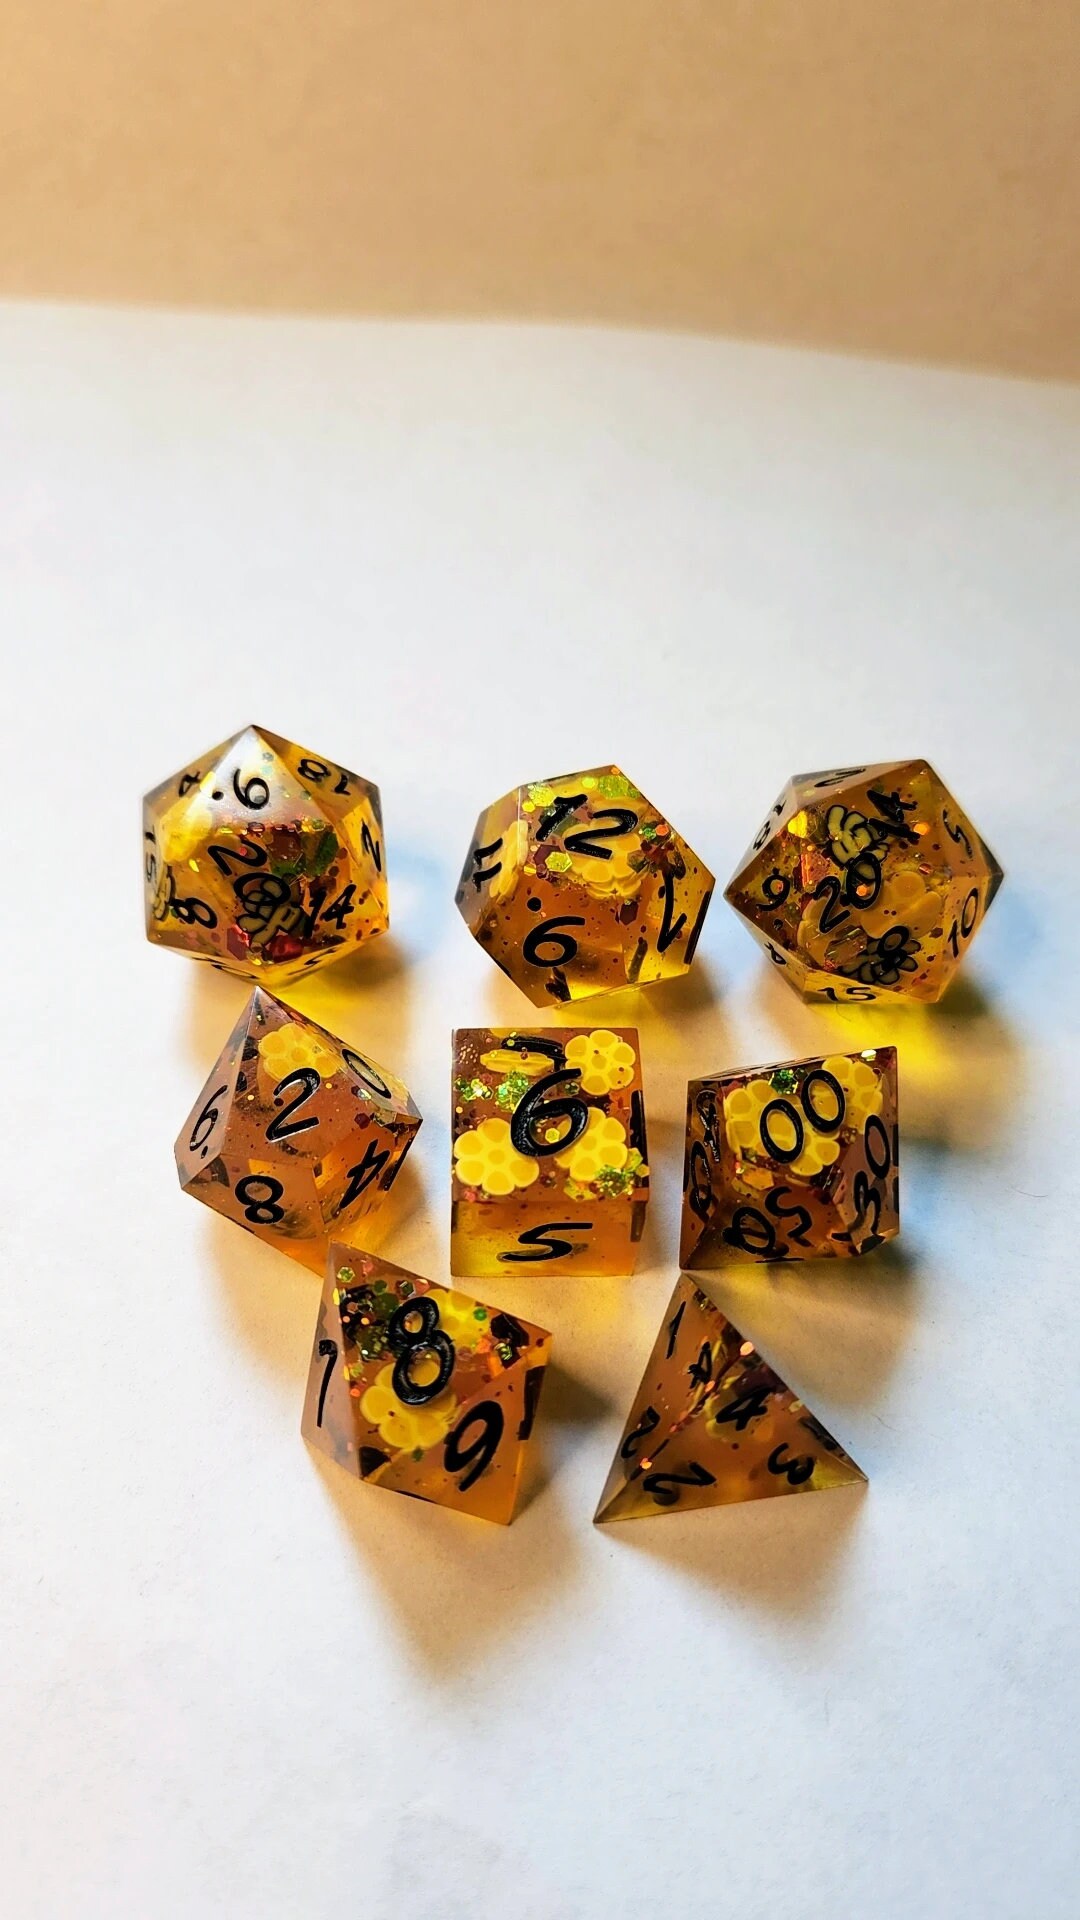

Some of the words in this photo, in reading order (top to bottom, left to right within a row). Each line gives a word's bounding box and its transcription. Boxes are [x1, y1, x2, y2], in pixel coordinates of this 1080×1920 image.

[535, 794, 639, 860] 12
[812, 852, 882, 935] 20
[948, 887, 979, 959] 10
[265, 1067, 321, 1143] 2
[510, 1067, 589, 1157] 6
[759, 1068, 846, 1164] 00
[234, 1174, 286, 1225] 8
[338, 1138, 390, 1210] 4
[499, 1222, 594, 1262] 5
[388, 1296, 456, 1406] 8
[664, 1301, 686, 1360] 1
[715, 1386, 774, 1431] 4
[642, 1461, 717, 1495] 2
[767, 1442, 816, 1486] 3
